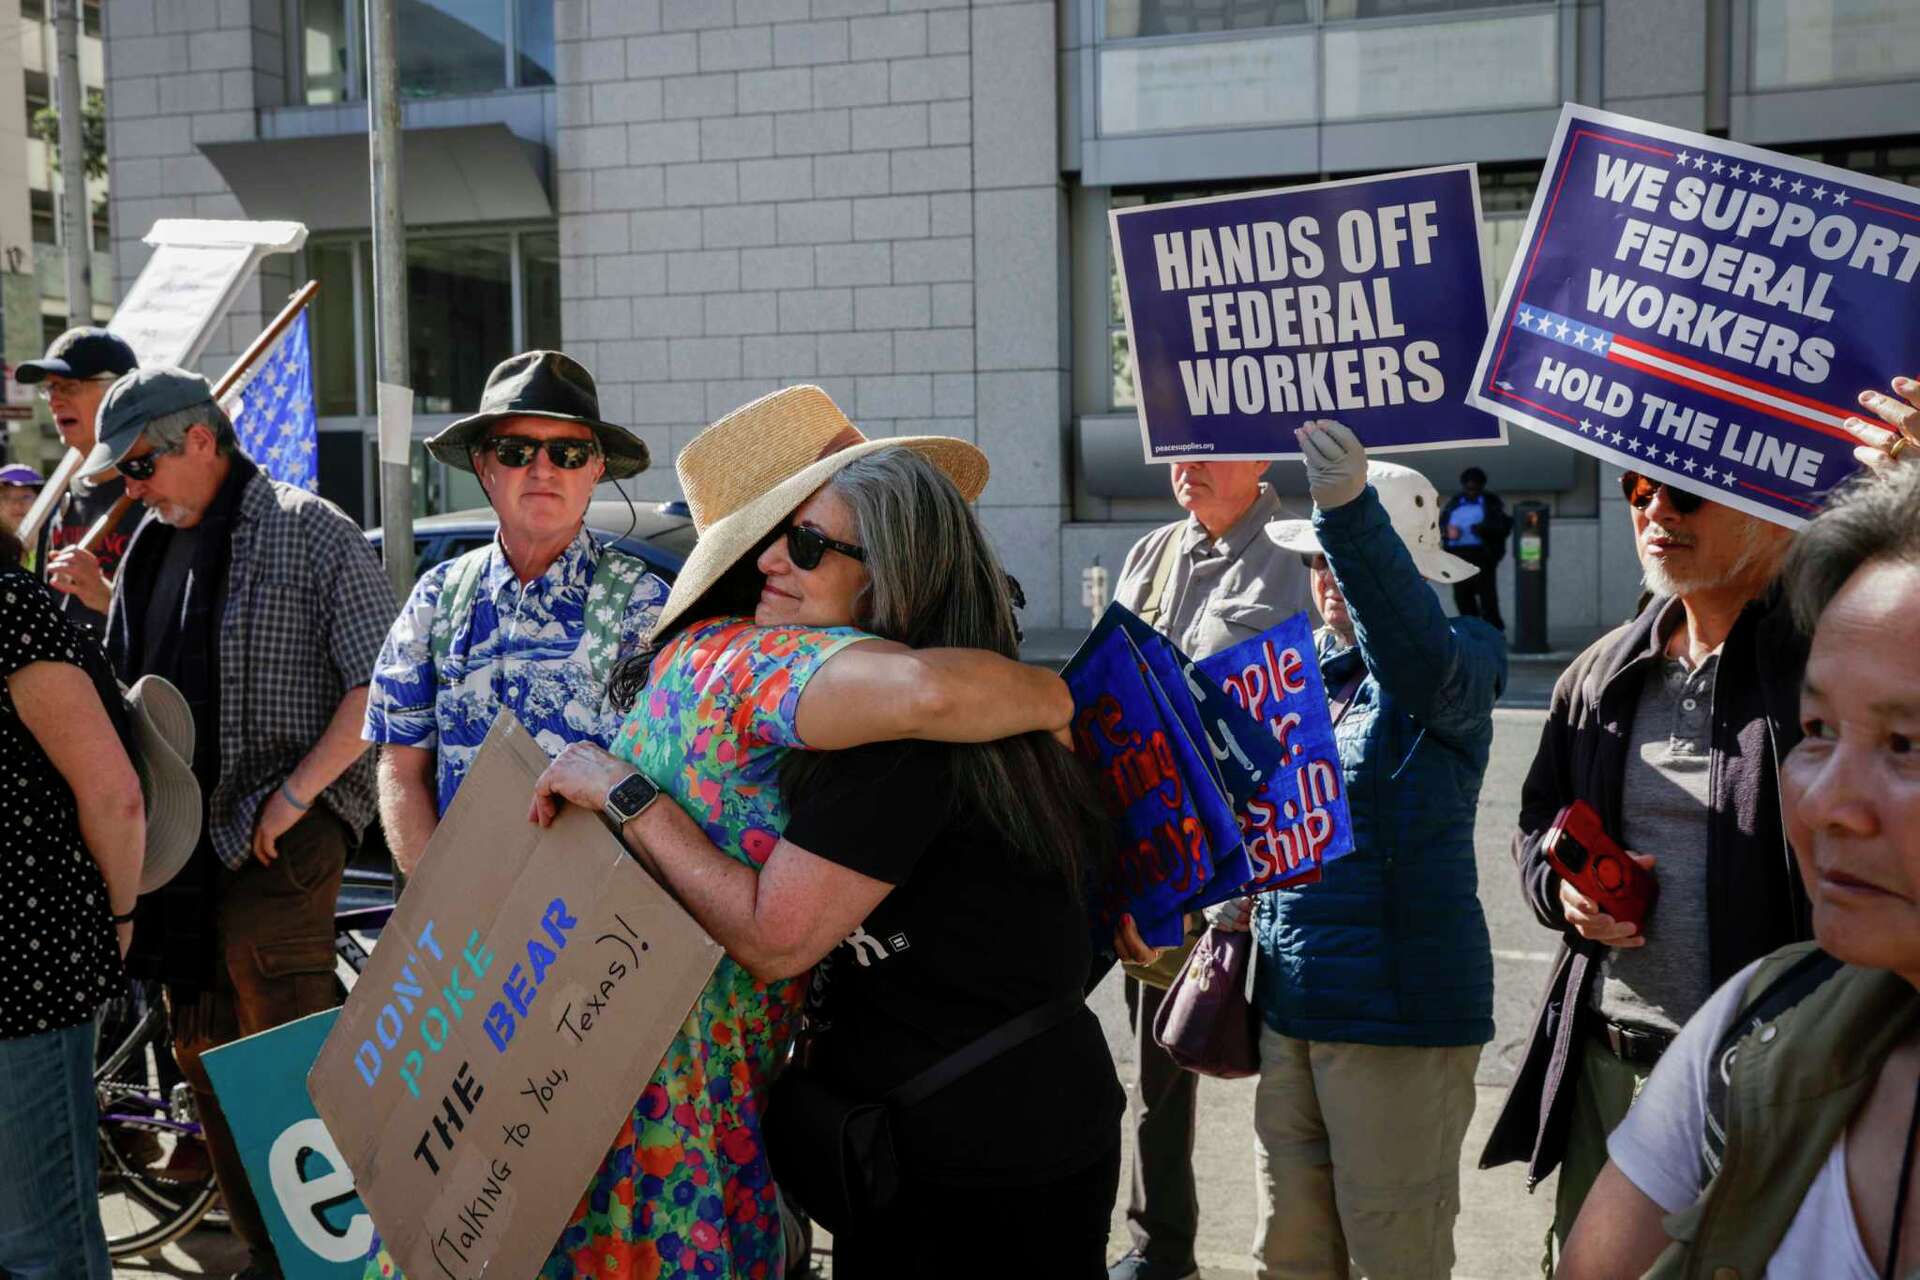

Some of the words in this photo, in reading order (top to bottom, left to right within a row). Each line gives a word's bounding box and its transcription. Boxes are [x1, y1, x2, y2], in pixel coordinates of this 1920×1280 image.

[1153, 216, 1325, 291] HANDS
[1337, 201, 1440, 274] OFF
[1594, 154, 1670, 213] WE
[1669, 176, 1920, 283] SUPPORT
[1615, 218, 1835, 322] FEDERAL
[1188, 277, 1405, 352] FEDERAL
[1585, 268, 1836, 384] WORKERS
[1178, 341, 1445, 417] WORKERS
[1534, 357, 1634, 418] HOLD
[1640, 395, 1719, 452] THE
[1720, 430, 1826, 488] LINE
[1155, 442, 1215, 454] peacesupplies.org
[353, 920, 446, 1087] DON'T
[400, 929, 494, 1098] POKE
[414, 1061, 486, 1176] THE
[482, 898, 578, 1053] BEAR
[504, 1123, 530, 1149] to
